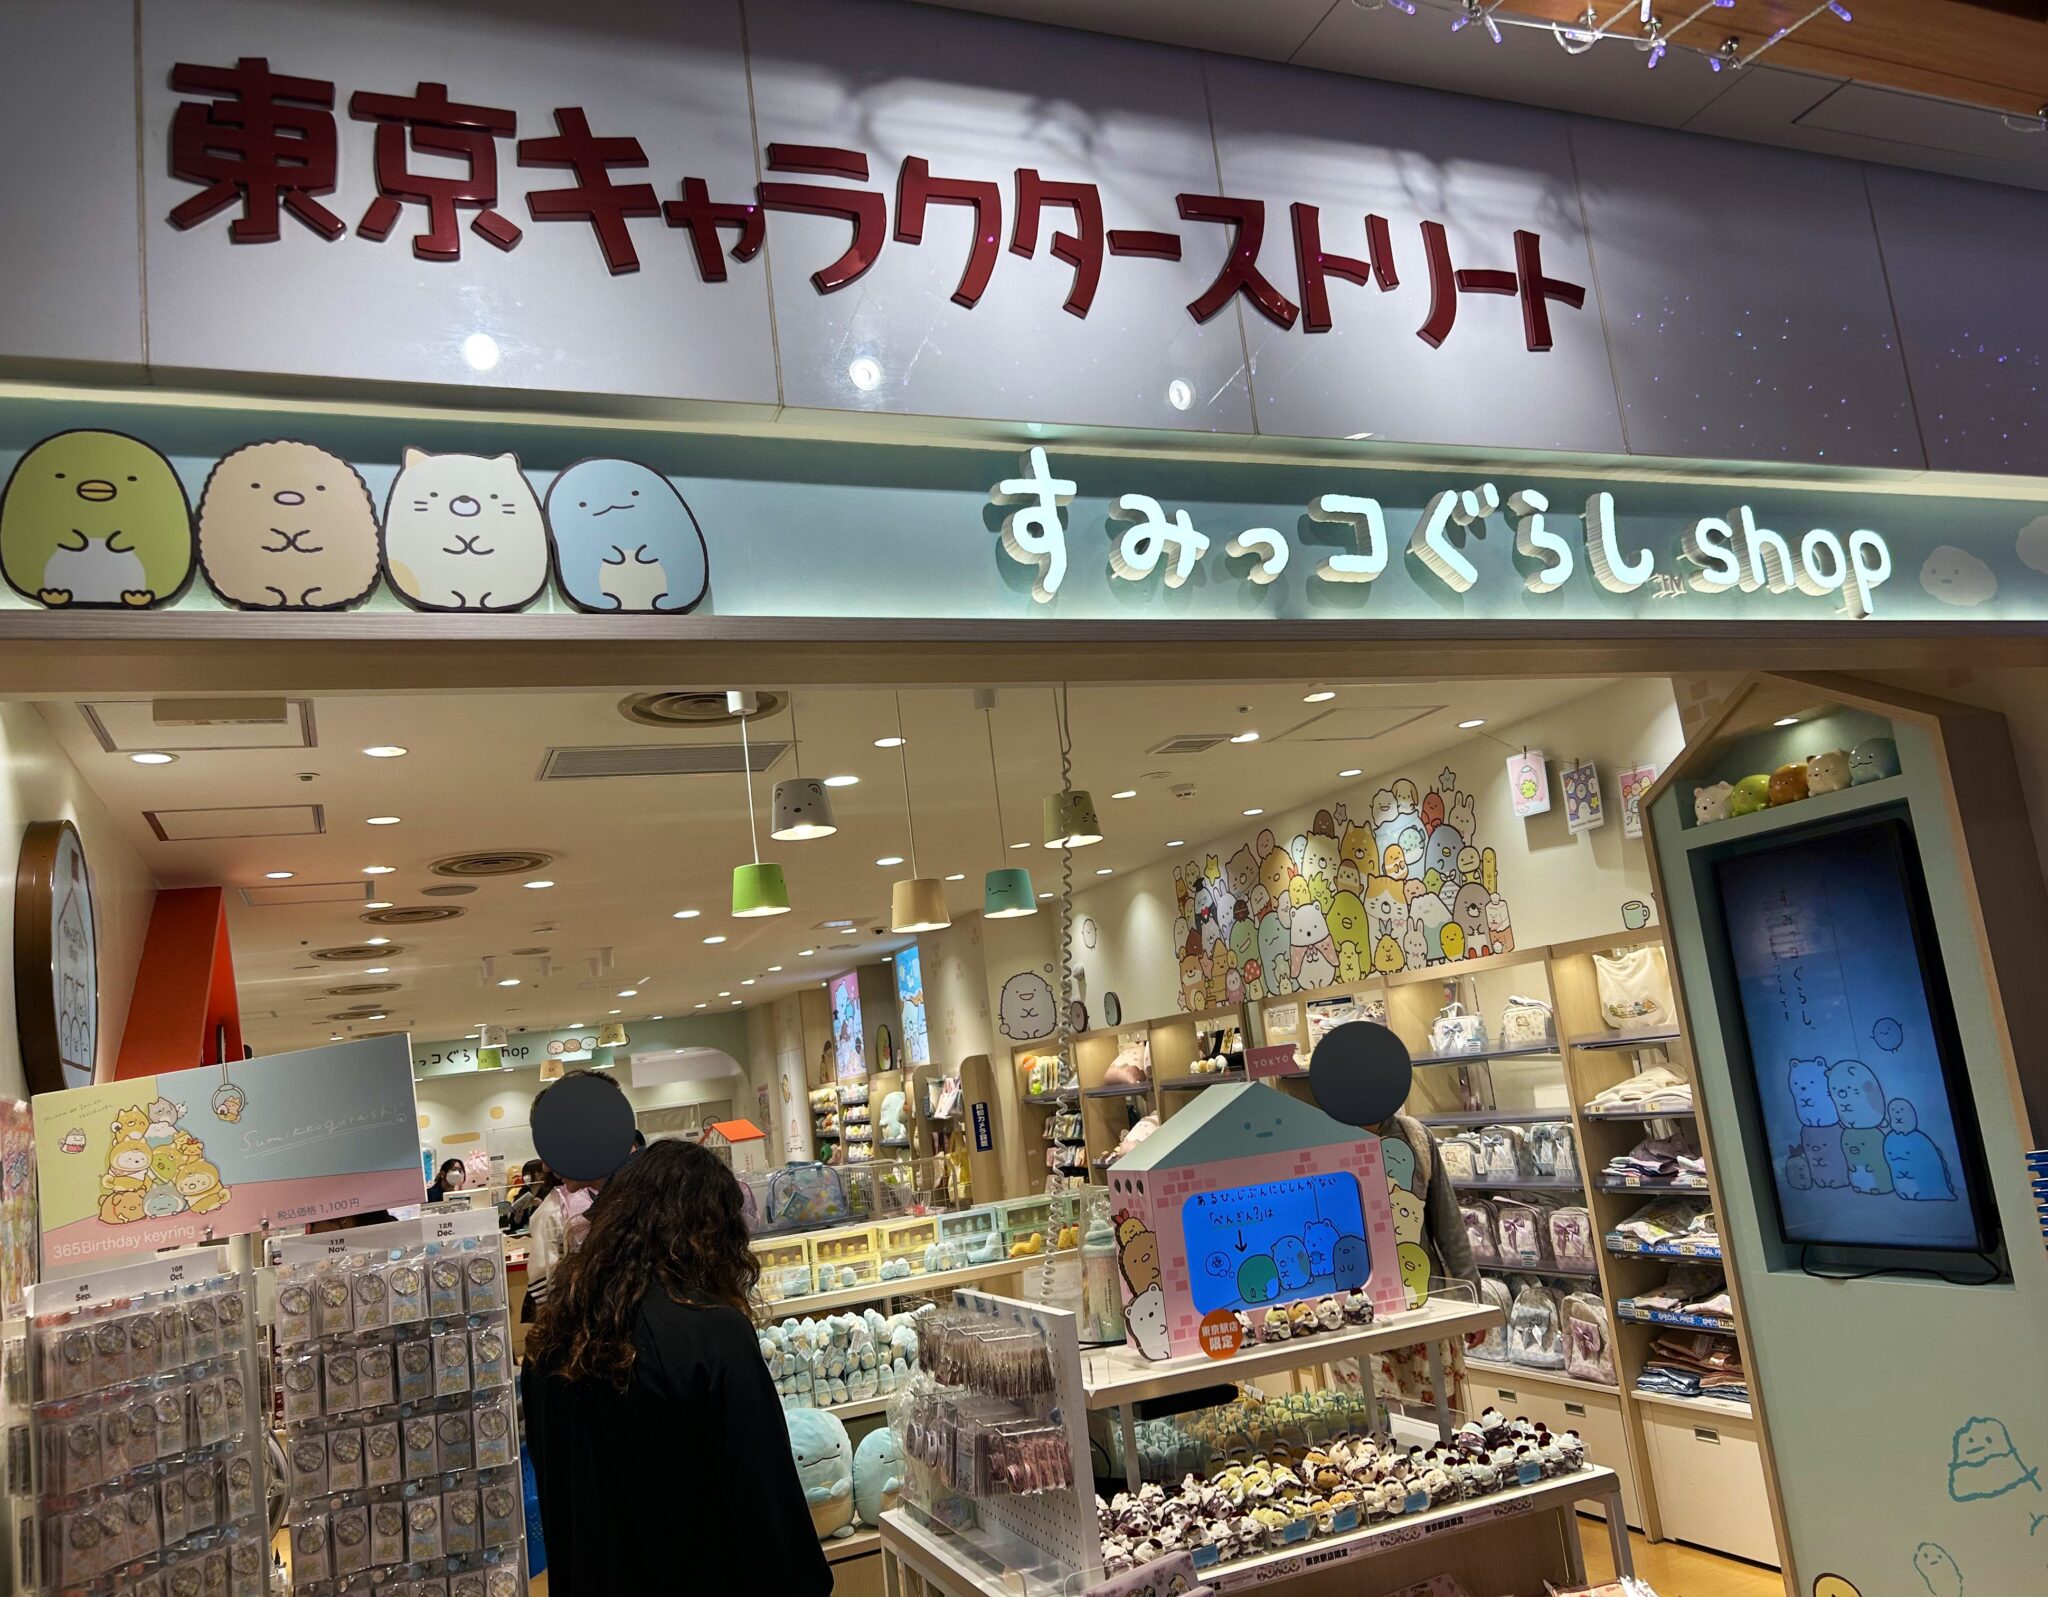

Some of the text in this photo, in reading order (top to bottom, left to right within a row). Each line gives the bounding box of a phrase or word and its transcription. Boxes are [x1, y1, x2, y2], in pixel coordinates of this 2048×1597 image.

[169, 57, 1585, 352] 東京キャラクターストリート
[991, 446, 1891, 619] すみっコぐらし shop
[502, 1046, 530, 1060] hop
[1253, 1054, 1289, 1068] TOKYO
[277, 1204, 317, 1221] 税込価格
[439, 1222, 453, 1230] 12月
[144, 1225, 196, 1243] keyring
[437, 1229, 455, 1238] Dec.
[330, 1238, 345, 1246] 11月
[328, 1246, 347, 1254] Nov.
[170, 1273, 184, 1282] Oct.
[75, 1292, 92, 1302] Sep.
[1658, 1312, 1678, 1322] SPECIAL
[1201, 1321, 1238, 1337] 東京駅店
[1209, 1335, 1234, 1351] 限定
[1305, 1548, 1348, 1567] 東京駅店限定
